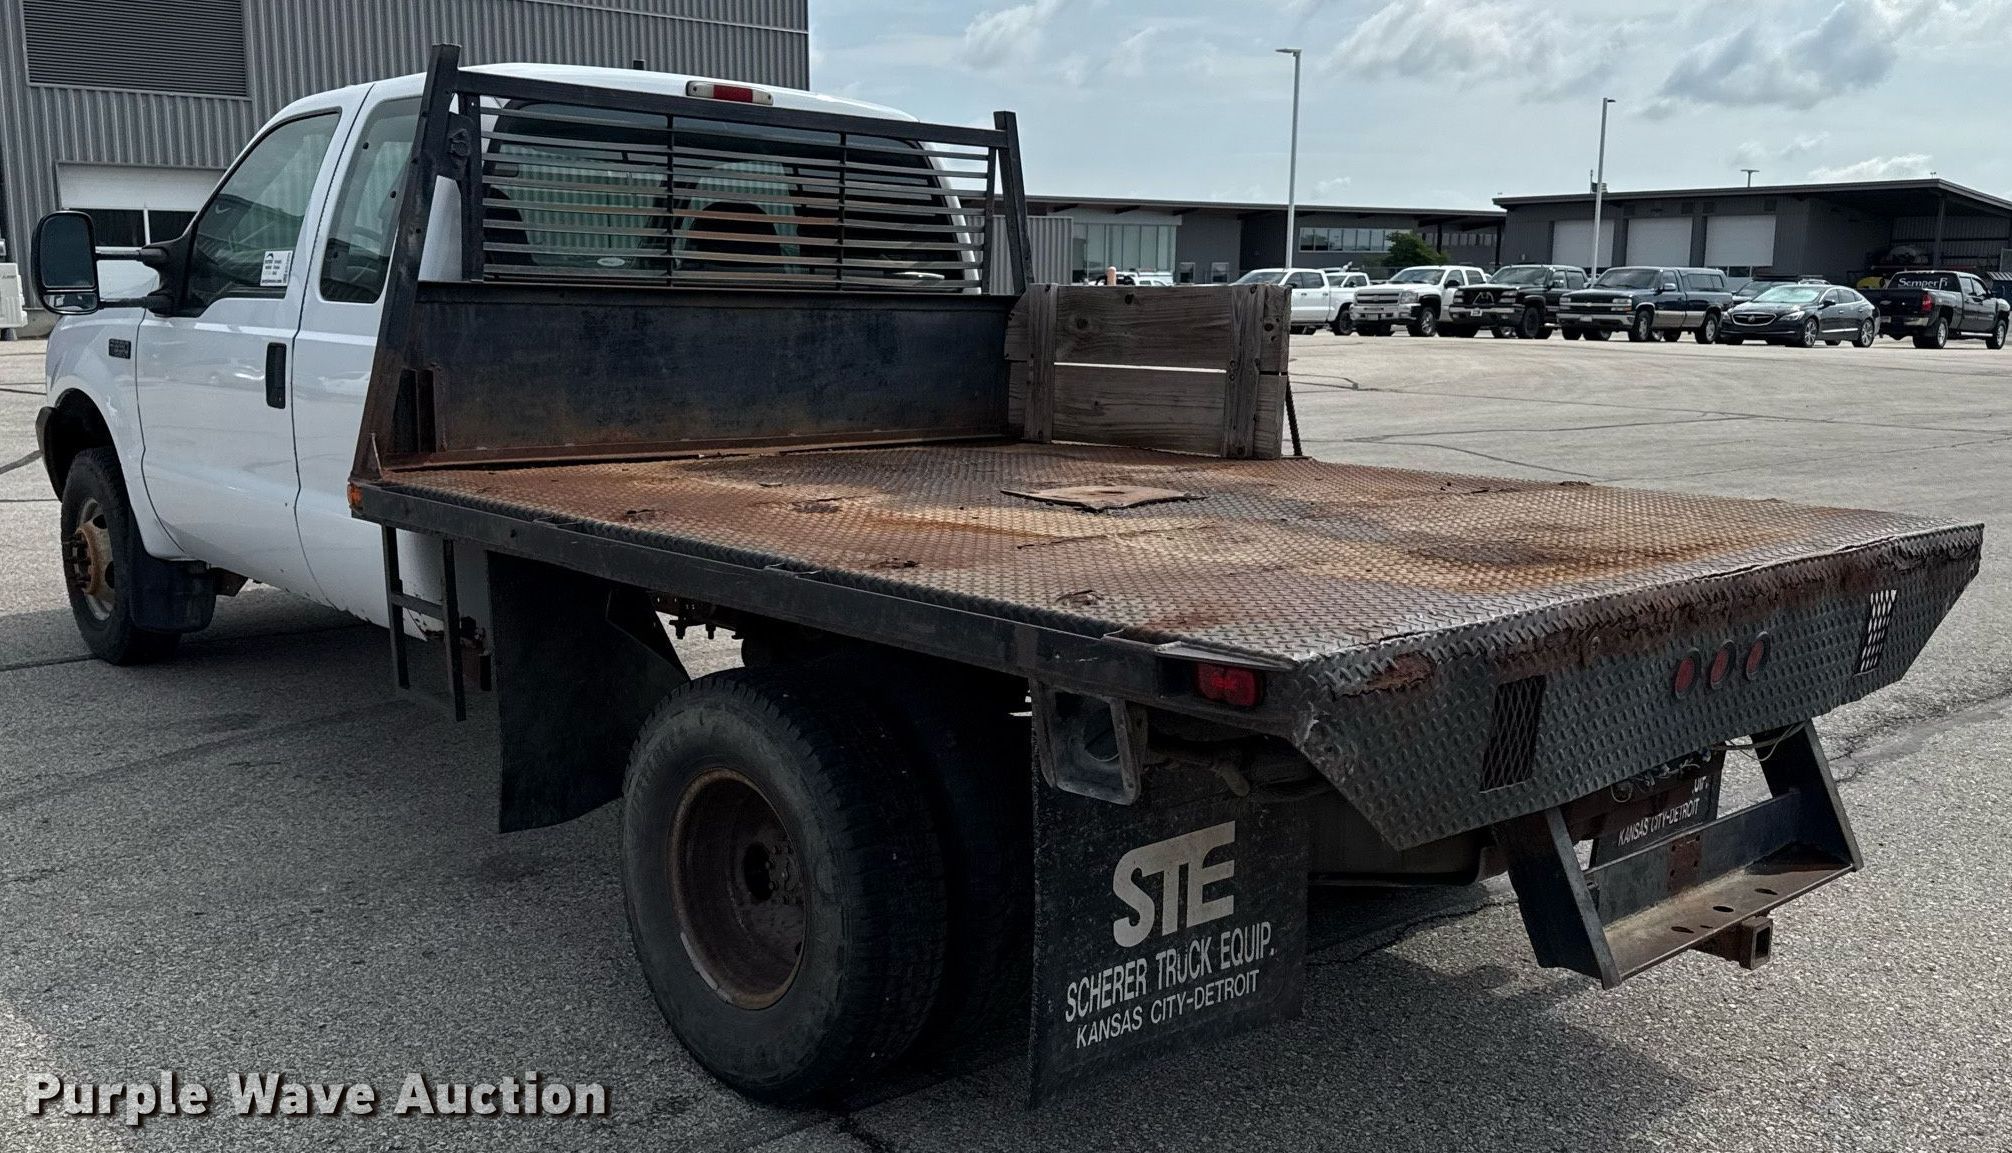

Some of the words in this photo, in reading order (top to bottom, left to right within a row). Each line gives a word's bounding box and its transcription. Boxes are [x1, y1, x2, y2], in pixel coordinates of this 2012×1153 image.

[1898, 277, 1938, 290] Semper
[1618, 817, 1649, 847] KANSAS
[1650, 798, 1701, 833] CITY-DETROIT
[1112, 820, 1236, 948] STE
[1065, 957, 1148, 1023] SCHERER
[1155, 937, 1213, 991] TRUCK
[1220, 921, 1276, 971] EQUIP.
[1076, 1007, 1143, 1049] KANSAS
[1150, 969, 1260, 1025] CITY-DETROIT
